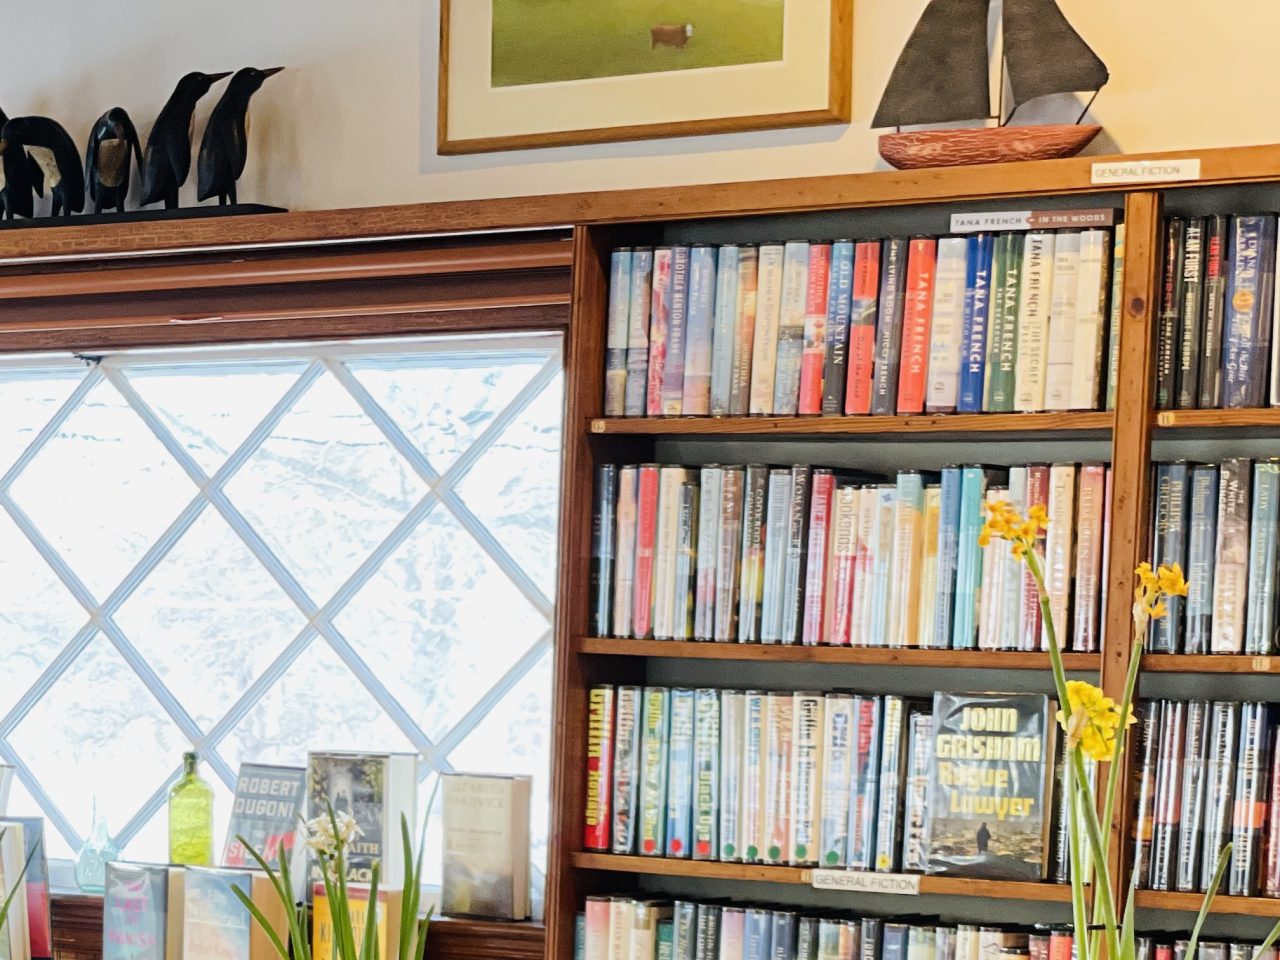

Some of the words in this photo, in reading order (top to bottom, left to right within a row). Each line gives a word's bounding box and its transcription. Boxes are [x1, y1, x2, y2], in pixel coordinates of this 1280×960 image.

[1095, 166, 1138, 178] GENERAL
[1140, 165, 1180, 176] FICTION
[954, 218, 981, 227] TANA
[984, 216, 1022, 226] FRENCH
[1038, 215, 1050, 223] IN
[1052, 214, 1069, 223] THE
[1071, 213, 1105, 223] WOODS
[1186, 227, 1201, 252] ALAN
[1030, 239, 1043, 274] TANA
[1183, 253, 1200, 283] FURST
[885, 264, 897, 293] LYING
[916, 272, 929, 308] TANA
[972, 270, 987, 310] TANA
[1005, 269, 1018, 308] TANA
[884, 295, 895, 323] ROOM
[1027, 275, 1041, 325] FRENCH
[881, 331, 892, 357] NICCI
[910, 311, 926, 374] FRENCH
[969, 314, 984, 373] FRENCH
[999, 310, 1015, 372] FRENCH
[878, 360, 890, 395] FRENCH
[1158, 475, 1170, 536] GREGORY
[1168, 480, 1182, 532] PHILIPPA
[1226, 479, 1239, 514] WHITE
[752, 488, 764, 550] COOKBOOK
[588, 689, 606, 758] Griffin
[960, 707, 1018, 732] JOHN
[936, 734, 1041, 761] GRISHAM
[237, 776, 301, 798] ROBERT
[938, 761, 1009, 791] Rogue
[235, 798, 296, 819] DUGONI
[585, 770, 601, 826] Hostage
[950, 791, 1035, 821] Lawyer
[815, 875, 867, 889] GENERAL
[871, 878, 916, 892] FICTION
